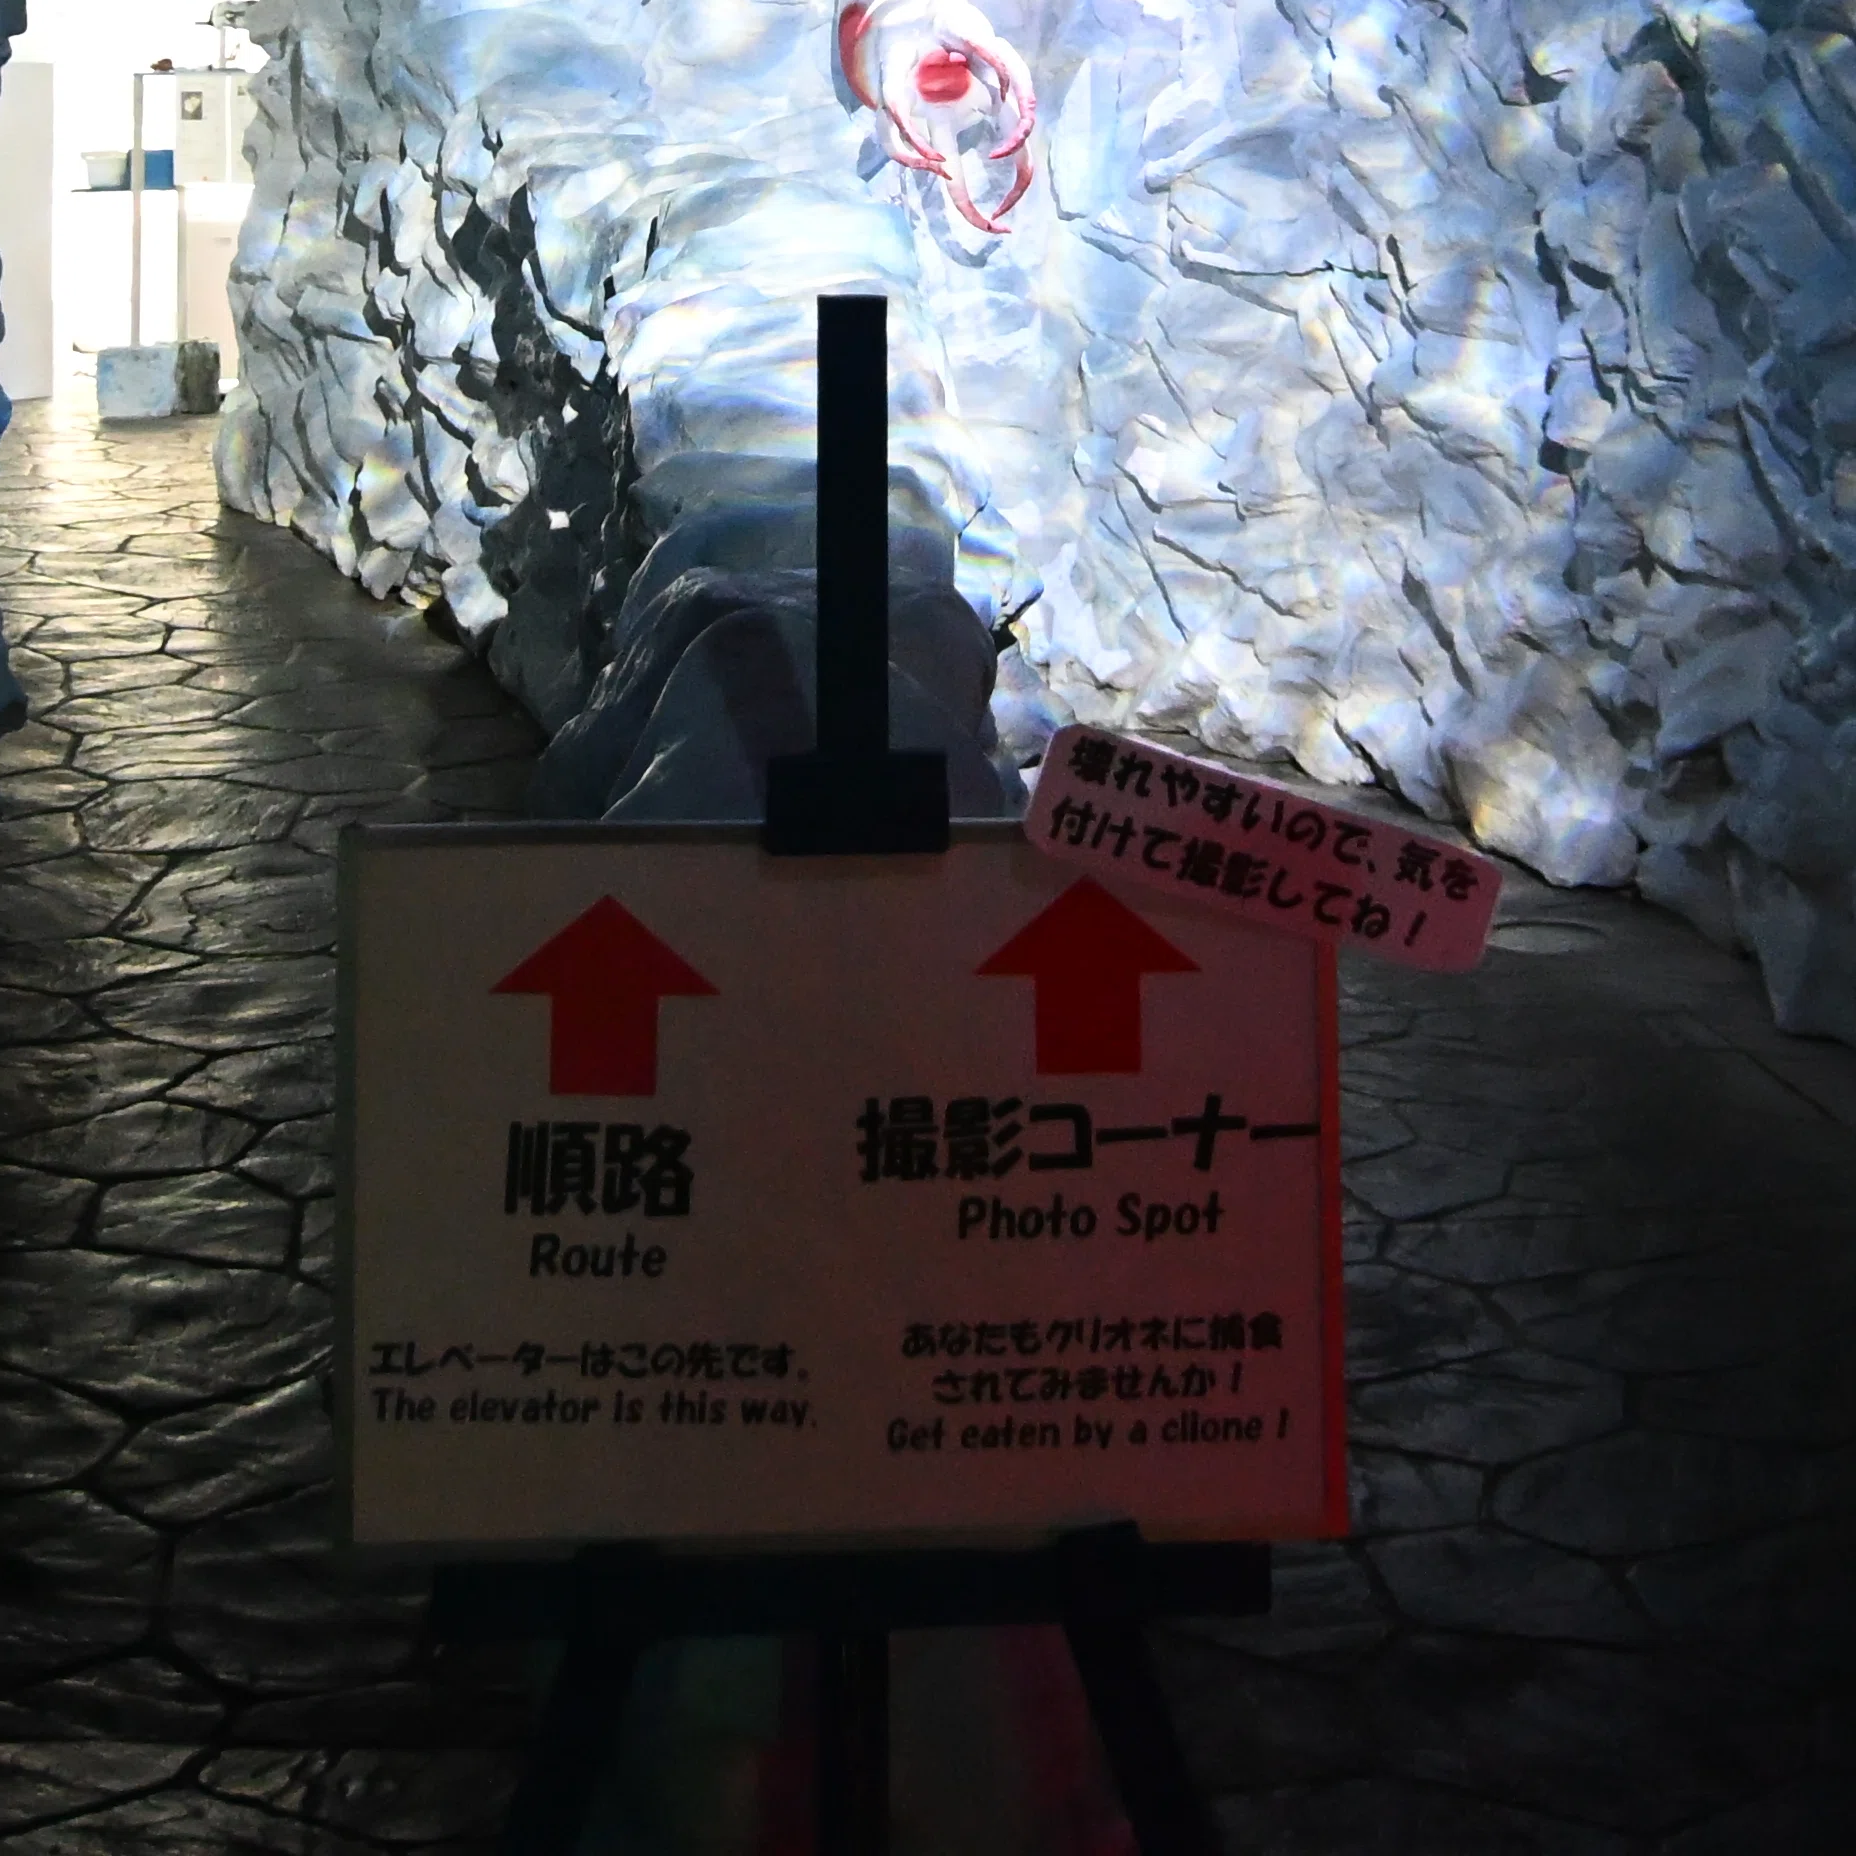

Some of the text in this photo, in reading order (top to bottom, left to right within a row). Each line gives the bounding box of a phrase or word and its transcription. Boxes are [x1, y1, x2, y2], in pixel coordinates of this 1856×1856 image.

[1068, 736, 1480, 901] 壊れやすいので、気を
[1048, 794, 1427, 947] 付けて撮影してね！
[856, 1093, 1322, 1183] 撮影コーナー
[504, 1120, 696, 1217] 順路
[956, 1190, 1226, 1241] Photo Spot
[528, 1231, 669, 1279] Route
[901, 1310, 1284, 1358] あなたもクリオネに捕食
[368, 1340, 810, 1380] エレベーターはこの先です。
[932, 1361, 1244, 1404] されてみませんか！
[371, 1388, 819, 1430] The elevator is this way.
[886, 1414, 946, 1452] Get
[960, 1416, 1062, 1449] eaten
[1073, 1412, 1114, 1450] by
[1128, 1422, 1148, 1445] a
